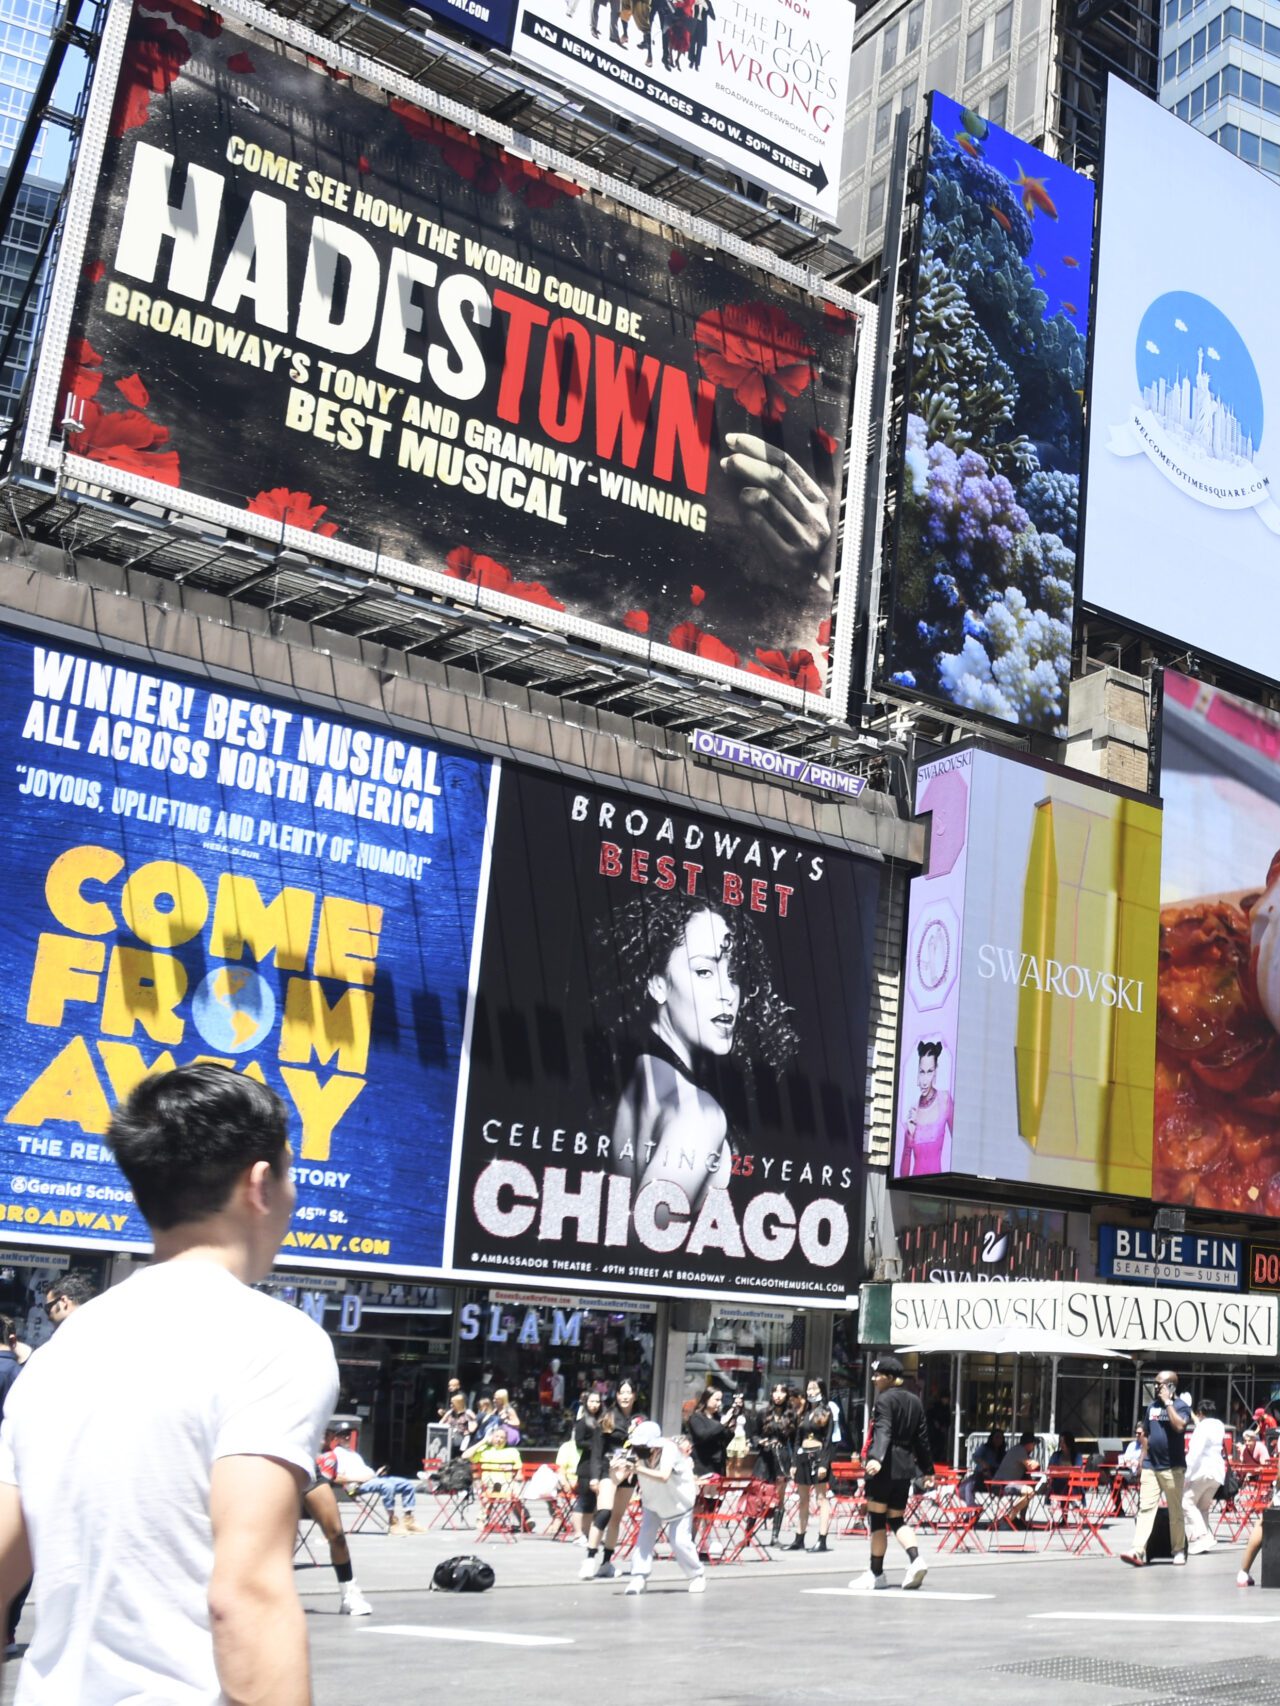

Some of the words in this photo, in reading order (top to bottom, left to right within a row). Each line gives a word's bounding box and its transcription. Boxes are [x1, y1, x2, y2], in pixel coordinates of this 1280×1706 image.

[720, 17, 768, 55] THAT
[773, 47, 838, 100] GOES
[733, 1, 768, 34] THE
[774, 19, 831, 67] PLAY
[561, 37, 596, 63] NEW
[596, 55, 645, 91] WORLD
[646, 83, 694, 116] STAGES
[700, 112, 726, 132] 340
[727, 124, 743, 142] W.
[745, 134, 771, 153] 50TH
[771, 148, 813, 179] STREET
[715, 81, 826, 147] BROADWAYGOESWRONG.COM
[716, 39, 835, 134] WRONG
[225, 135, 303, 192] COME
[304, 170, 351, 212] SEE
[352, 190, 413, 237] HOW
[415, 216, 461, 260] THE
[463, 237, 541, 295] WORLD
[543, 275, 613, 327] COULD
[614, 303, 646, 342] BE.
[114, 140, 717, 496] HADESTOWN
[104, 281, 311, 384] BROADWAY'S
[402, 395, 460, 440] AND
[285, 386, 392, 460] BEST
[397, 427, 568, 527] MUSICAL
[1133, 416, 1271, 499] WELCOMETOTIMESSQUARE.COM
[32, 646, 197, 733] WINNER!
[203, 692, 293, 756] BEST
[297, 715, 443, 796] MUSICAL
[22, 700, 81, 751] ALL
[87, 715, 211, 780] ACROSS
[216, 747, 309, 804] NORTH
[313, 772, 436, 834] AMERICA
[916, 750, 973, 783] SWAROVSKI
[111, 785, 212, 835] UPLIFTING
[213, 809, 254, 844] AND
[258, 819, 328, 857] PLENTY
[329, 835, 354, 864] OF
[570, 795, 824, 882] BROADWAY'S
[44, 843, 384, 987] COME
[599, 841, 704, 896] BEST
[722, 871, 796, 918] BET
[26, 932, 375, 1075] FROM
[977, 944, 1145, 1014] SWAROVSKI
[17, 1135, 64, 1157] THE
[482, 1118, 721, 1174] CELEBRATING
[730, 1153, 755, 1177] 25
[761, 1156, 852, 1189] YEARS
[27, 1178, 82, 1198] Gerald
[295, 1205, 326, 1221] 45TH
[328, 1209, 349, 1225] St.
[473, 1158, 850, 1268] CHICAGO
[480, 1253, 549, 1269] AMBASSADOR
[551, 1259, 592, 1272] THEATRE
[601, 1265, 625, 1275] 49TH
[628, 1266, 660, 1278] STREET
[662, 1270, 674, 1280] AT
[676, 1270, 726, 1284] BROADWAY
[734, 1276, 846, 1293] CHICAGOTHEMUSICAL.COM
[1115, 1229, 1184, 1263] BLUE
[1196, 1239, 1237, 1268] FIN
[1115, 1261, 1181, 1279] SEAFOOD
[1196, 1269, 1238, 1283] SUSHI
[459, 1302, 583, 1347] SLAM
[1066, 1291, 1273, 1347] SWAROVSKI
